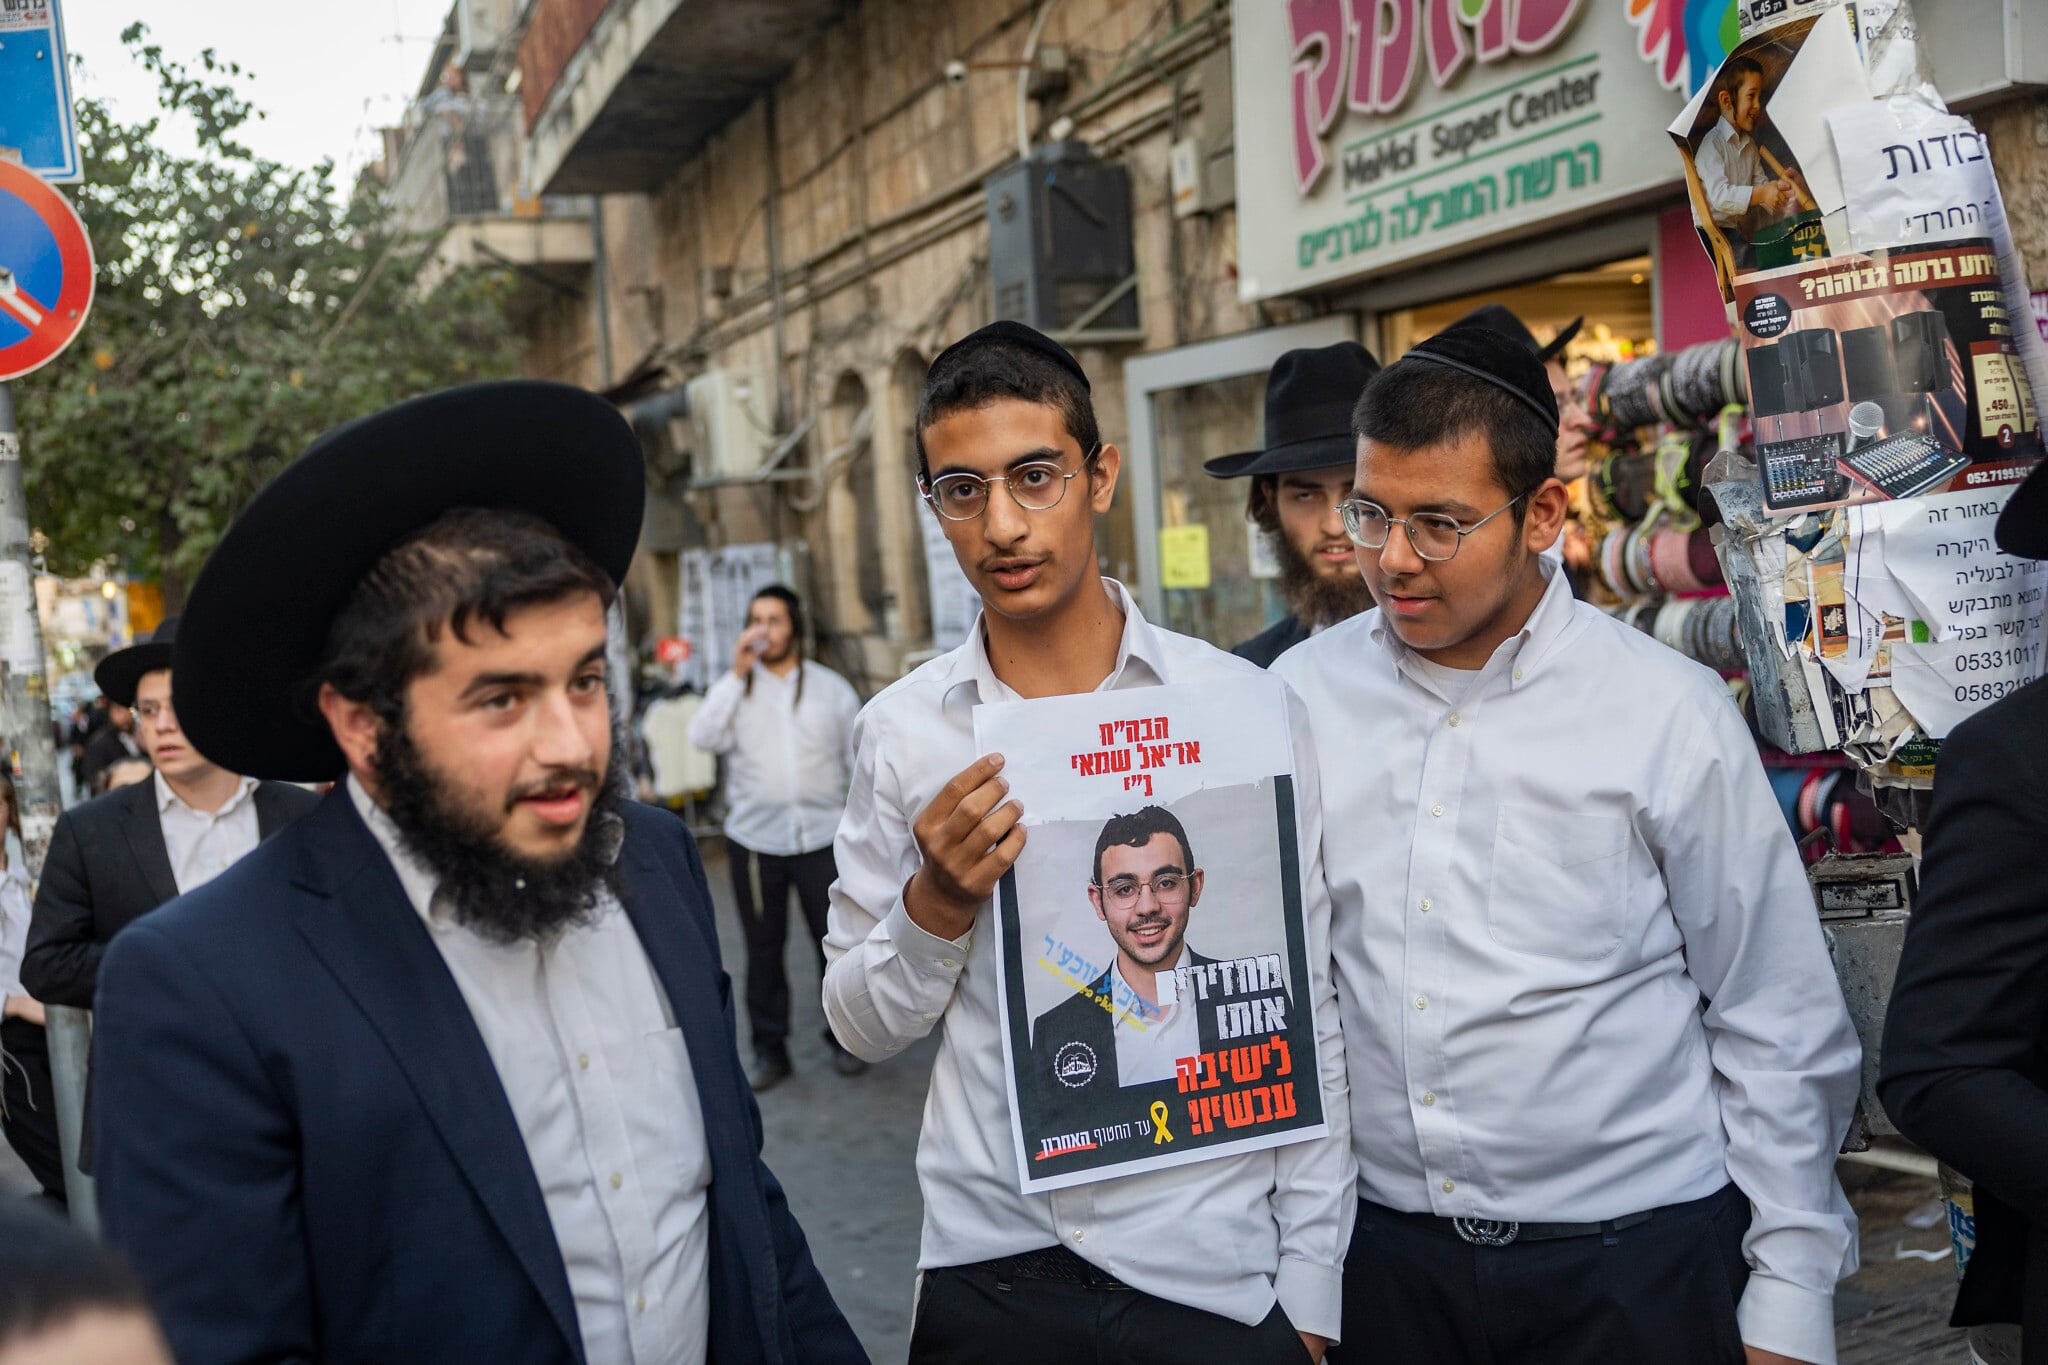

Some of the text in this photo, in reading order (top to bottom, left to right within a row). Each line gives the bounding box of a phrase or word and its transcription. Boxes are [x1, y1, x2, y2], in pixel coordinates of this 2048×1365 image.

[1432, 108, 1502, 158] Super
[1507, 71, 1600, 128] Center
[1505, 140, 1601, 207] הרשת
[1389, 174, 1498, 244] המובילה
[1800, 266, 1889, 300] גבוהה?
[1894, 257, 1955, 285] ברמה
[1992, 399, 2009, 411] 450
[2002, 429, 2011, 443] 2
[1928, 501, 2001, 523] באזור זה
[1936, 538, 1989, 558] היקרה
[1956, 561, 2014, 585] לבעליה
[1948, 594, 2012, 616] מתבקש
[1994, 620, 2025, 637] קשר
[1071, 740, 1201, 777] אריאל שמאי
[1154, 953, 1283, 1006] מחזירים
[1215, 995, 1288, 1040] אותו
[1175, 1035, 1292, 1094] לישיבה
[1187, 1082, 1297, 1136] עכשיו!
[1040, 1119, 1151, 1157] עד החטוף האחרון
